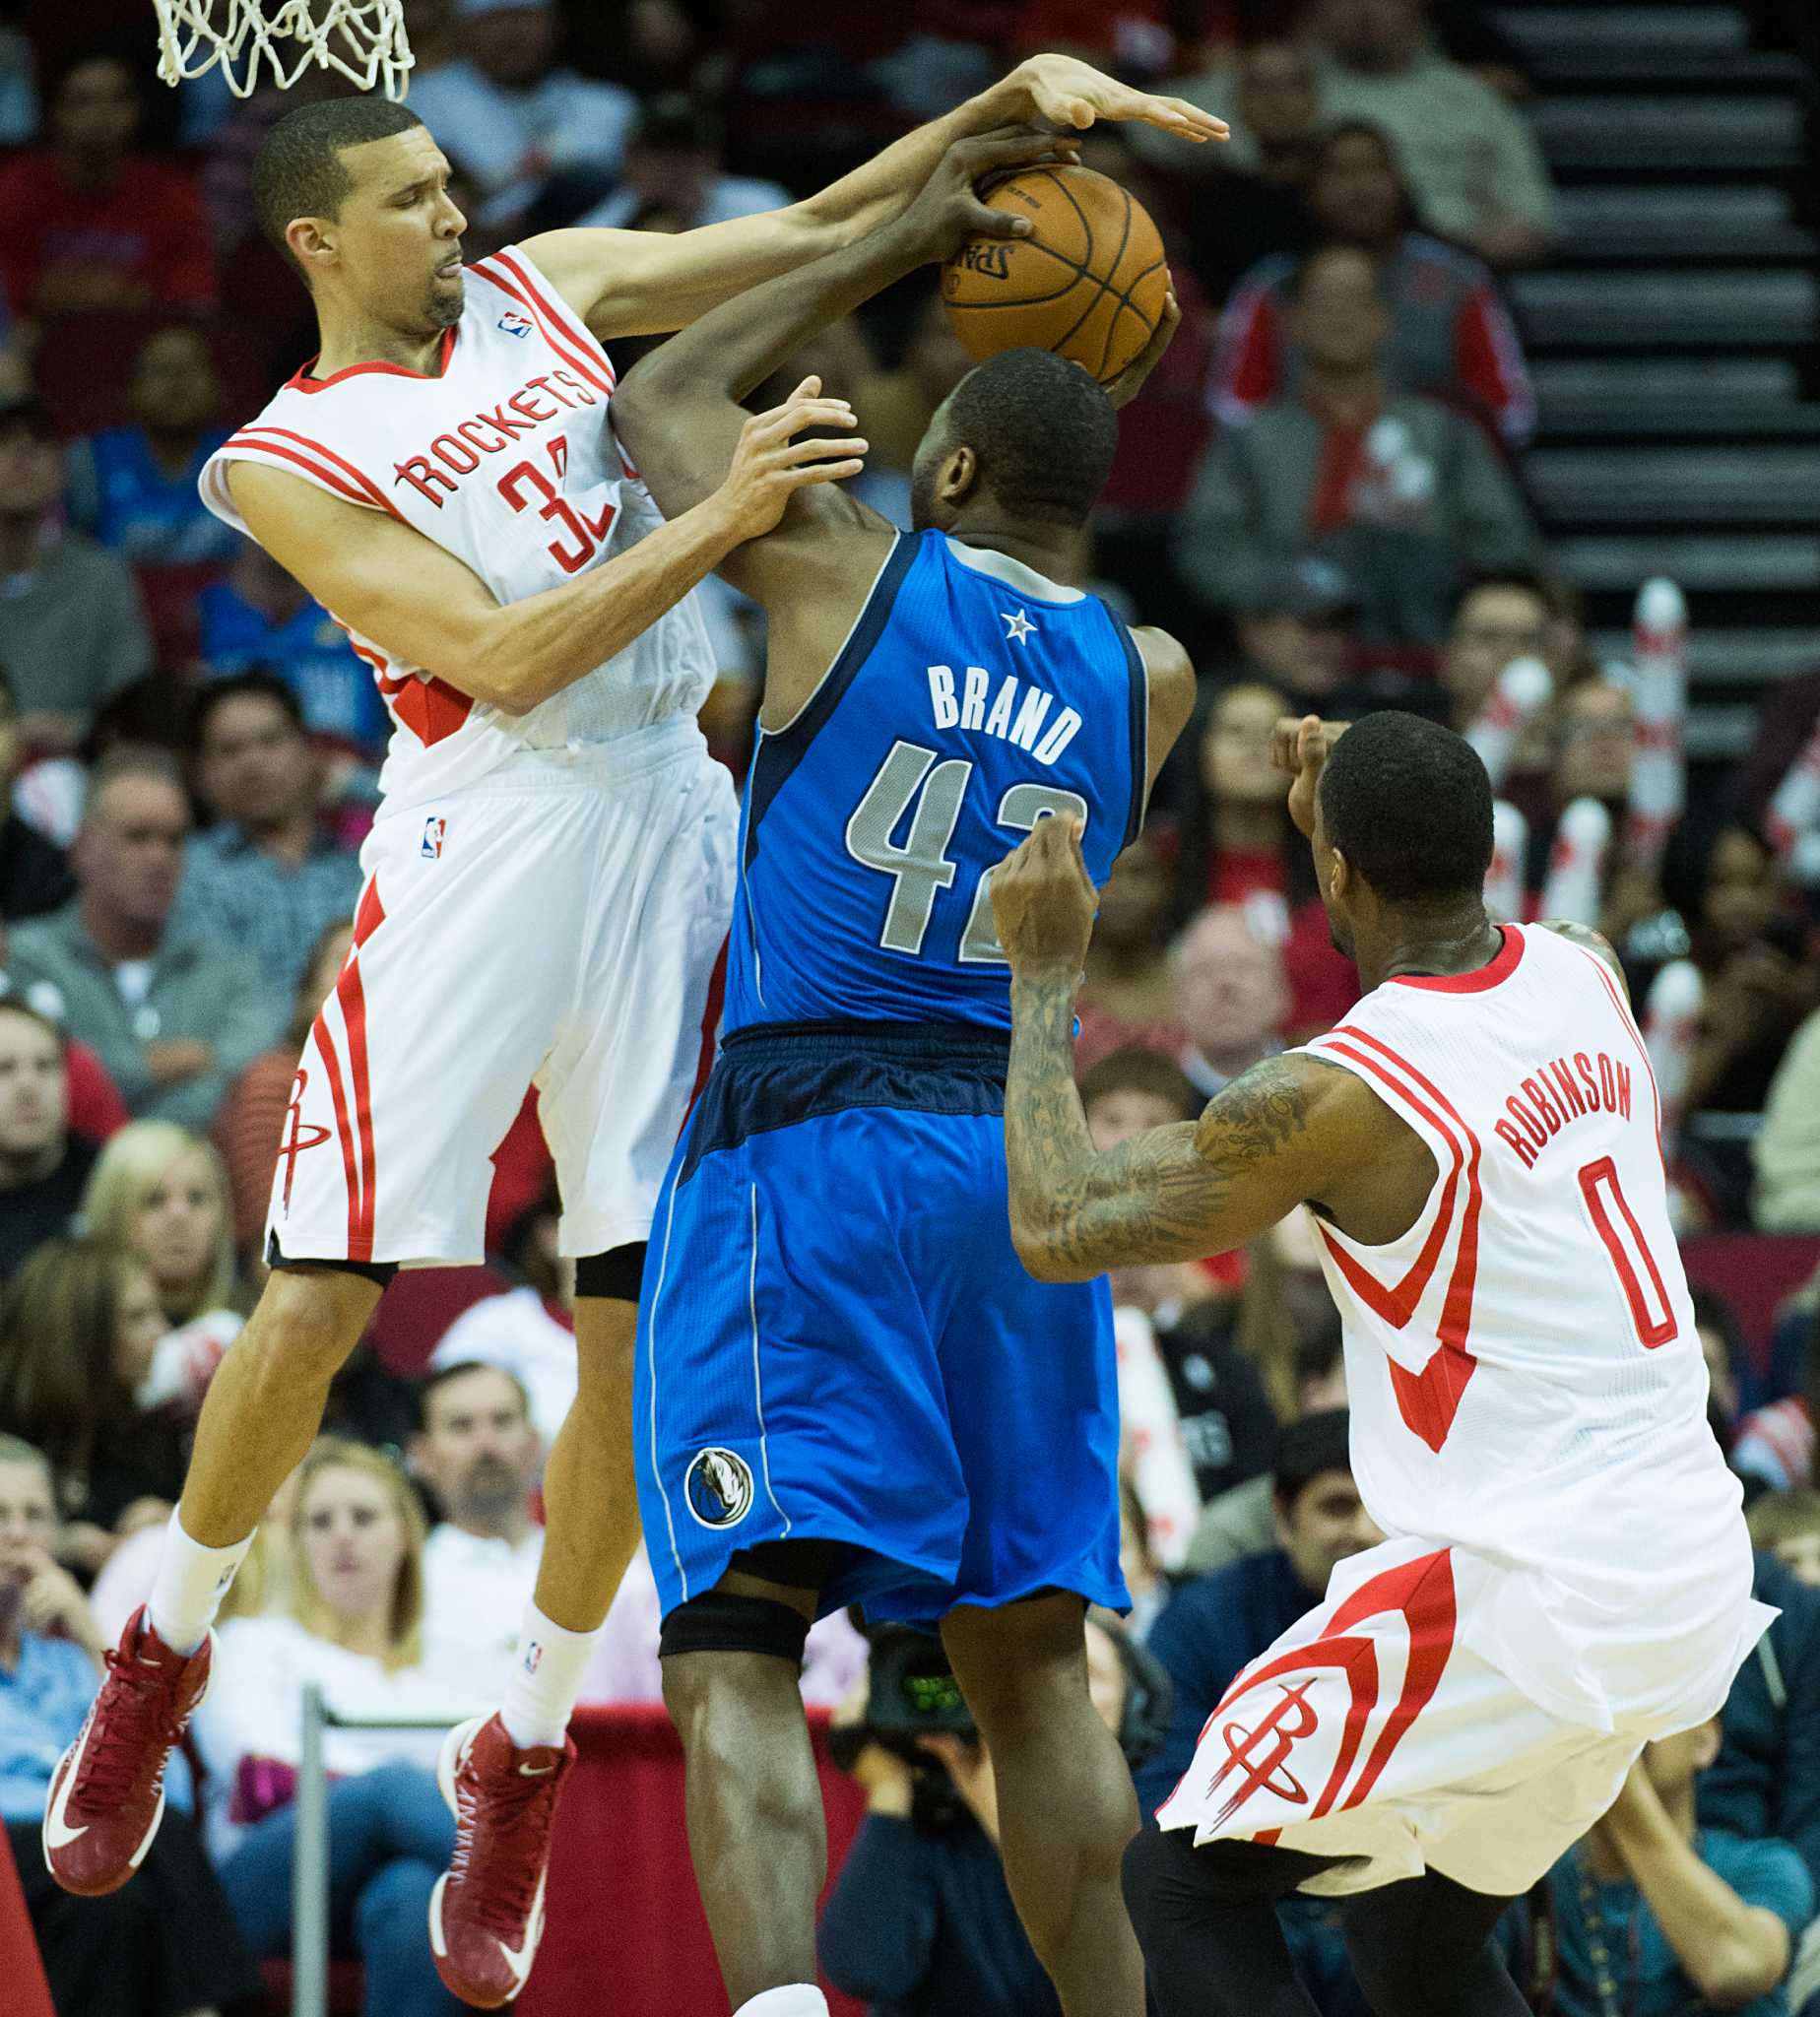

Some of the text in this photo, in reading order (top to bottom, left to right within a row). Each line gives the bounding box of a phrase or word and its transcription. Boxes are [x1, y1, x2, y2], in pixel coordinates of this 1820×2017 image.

[393, 369, 597, 510] ROCKETS
[496, 434, 617, 573] 32
[927, 664, 1082, 766] BRAND
[845, 740, 1088, 963] 42
[1493, 1051, 1631, 1171] ROBINSON
[1578, 1155, 1678, 1350] 0
